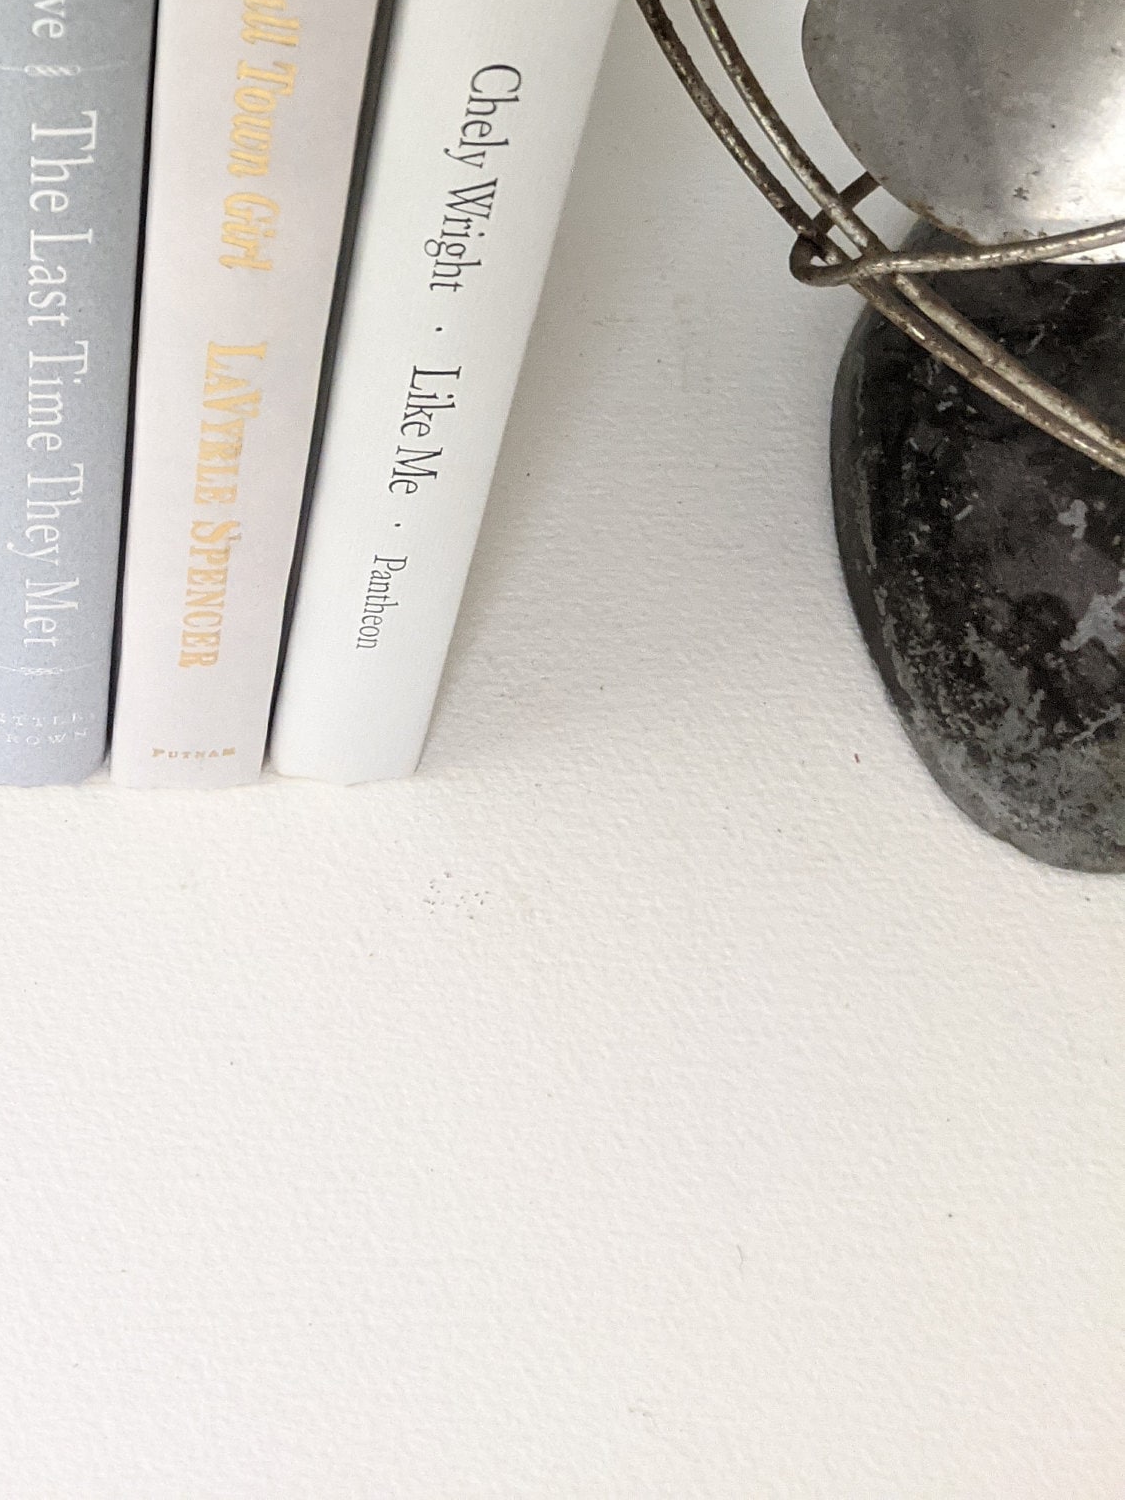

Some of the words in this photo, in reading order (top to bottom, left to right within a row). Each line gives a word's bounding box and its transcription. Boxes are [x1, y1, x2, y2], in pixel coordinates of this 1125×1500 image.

[29, 109, 98, 214] The
[227, 59, 299, 179] Town
[443, 63, 522, 170] Chely
[26, 229, 94, 330] Last
[217, 189, 281, 272] Girl
[423, 177, 500, 292] Wright
[25, 339, 89, 453] Time
[399, 364, 463, 439] Like
[6, 462, 85, 568] They
[388, 444, 444, 496] Me
[23, 577, 80, 648] Met
[177, 519, 242, 670] SPENCER
[355, 553, 408, 651] Pantheon
